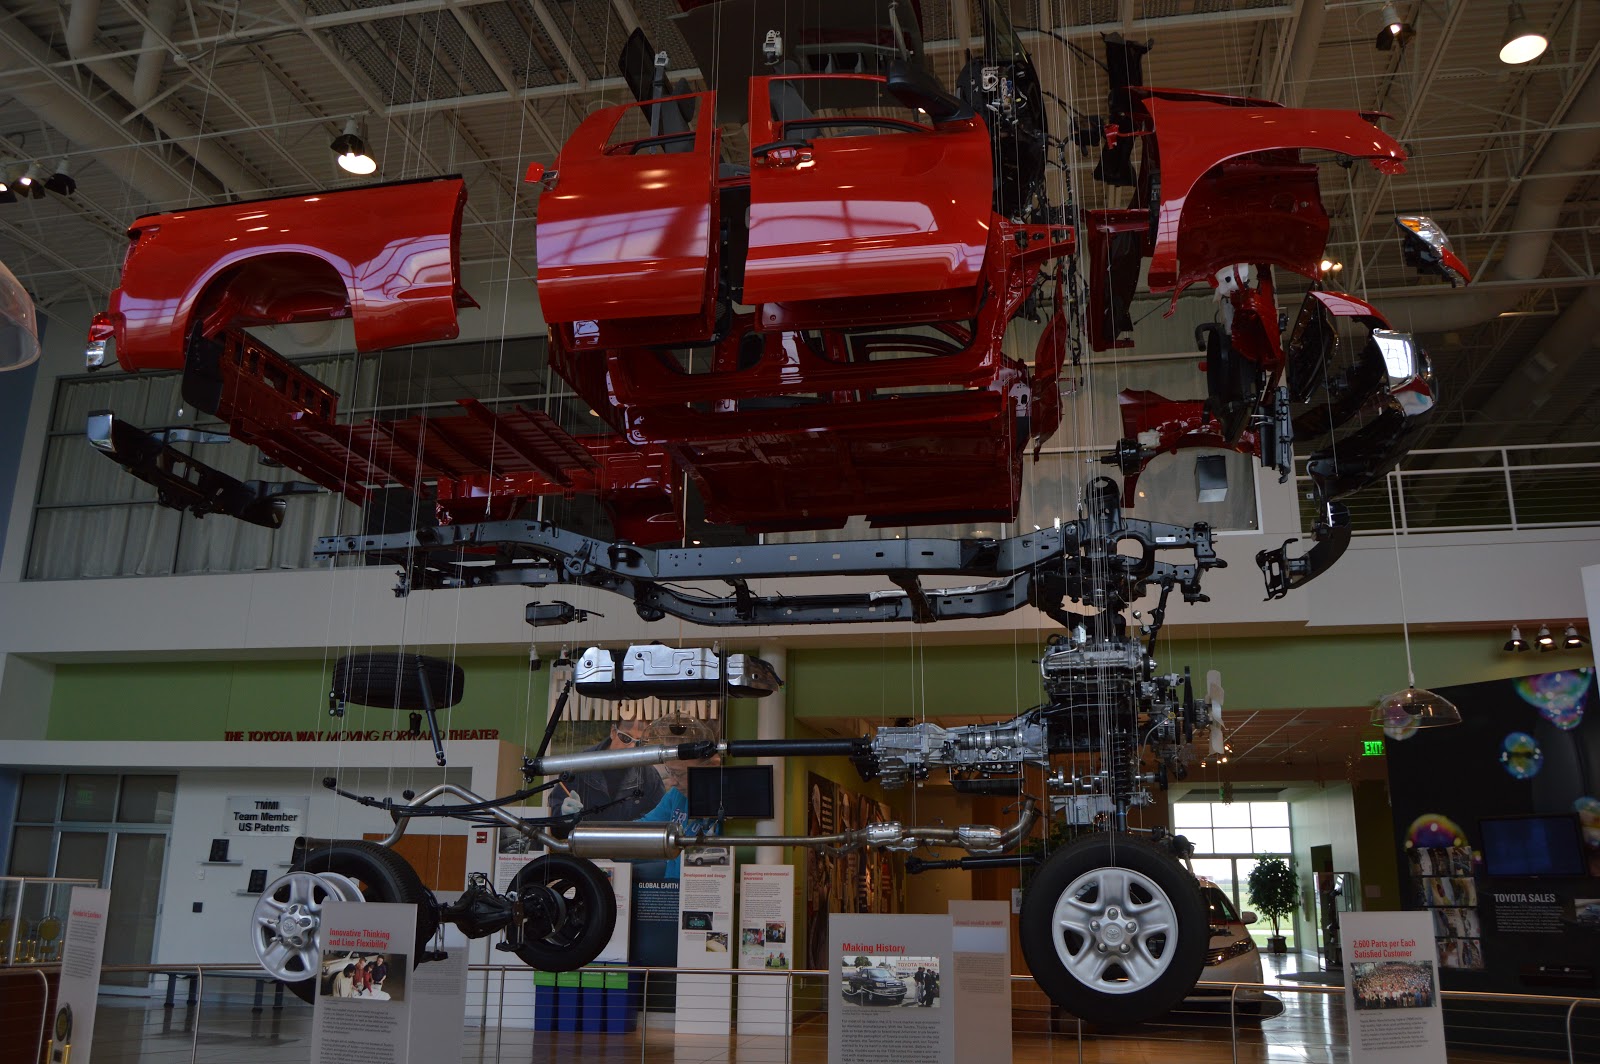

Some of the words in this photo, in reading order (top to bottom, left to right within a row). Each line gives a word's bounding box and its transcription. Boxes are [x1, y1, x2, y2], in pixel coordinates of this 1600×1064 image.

[224, 731, 244, 741] THE
[248, 731, 293, 741] TOYOTA
[296, 731, 324, 741] WAY
[326, 730, 380, 741] MOVING
[448, 729, 499, 740] THEATER
[1364, 741, 1382, 754] EXIT
[254, 801, 279, 810] TMMI
[234, 812, 258, 821] Team
[260, 812, 298, 821] Member
[239, 823, 252, 832] US
[254, 823, 290, 832] Patents
[660, 882, 679, 890] EARTH
[1493, 893, 1528, 903] TOYOTA
[1528, 893, 1556, 903] SALES
[329, 928, 361, 938] Innovative
[363, 929, 390, 940] Thinking
[341, 939, 354, 947] Line
[356, 939, 388, 950] Flexibility
[842, 942, 874, 954] Making
[876, 943, 906, 954] History
[1353, 940, 1370, 949] 2,600
[1371, 940, 1388, 948] Parts
[1389, 940, 1400, 949] per
[1400, 938, 1416, 948] Each
[1354, 949, 1382, 959] Satisfied
[1383, 949, 1412, 958] Customer
